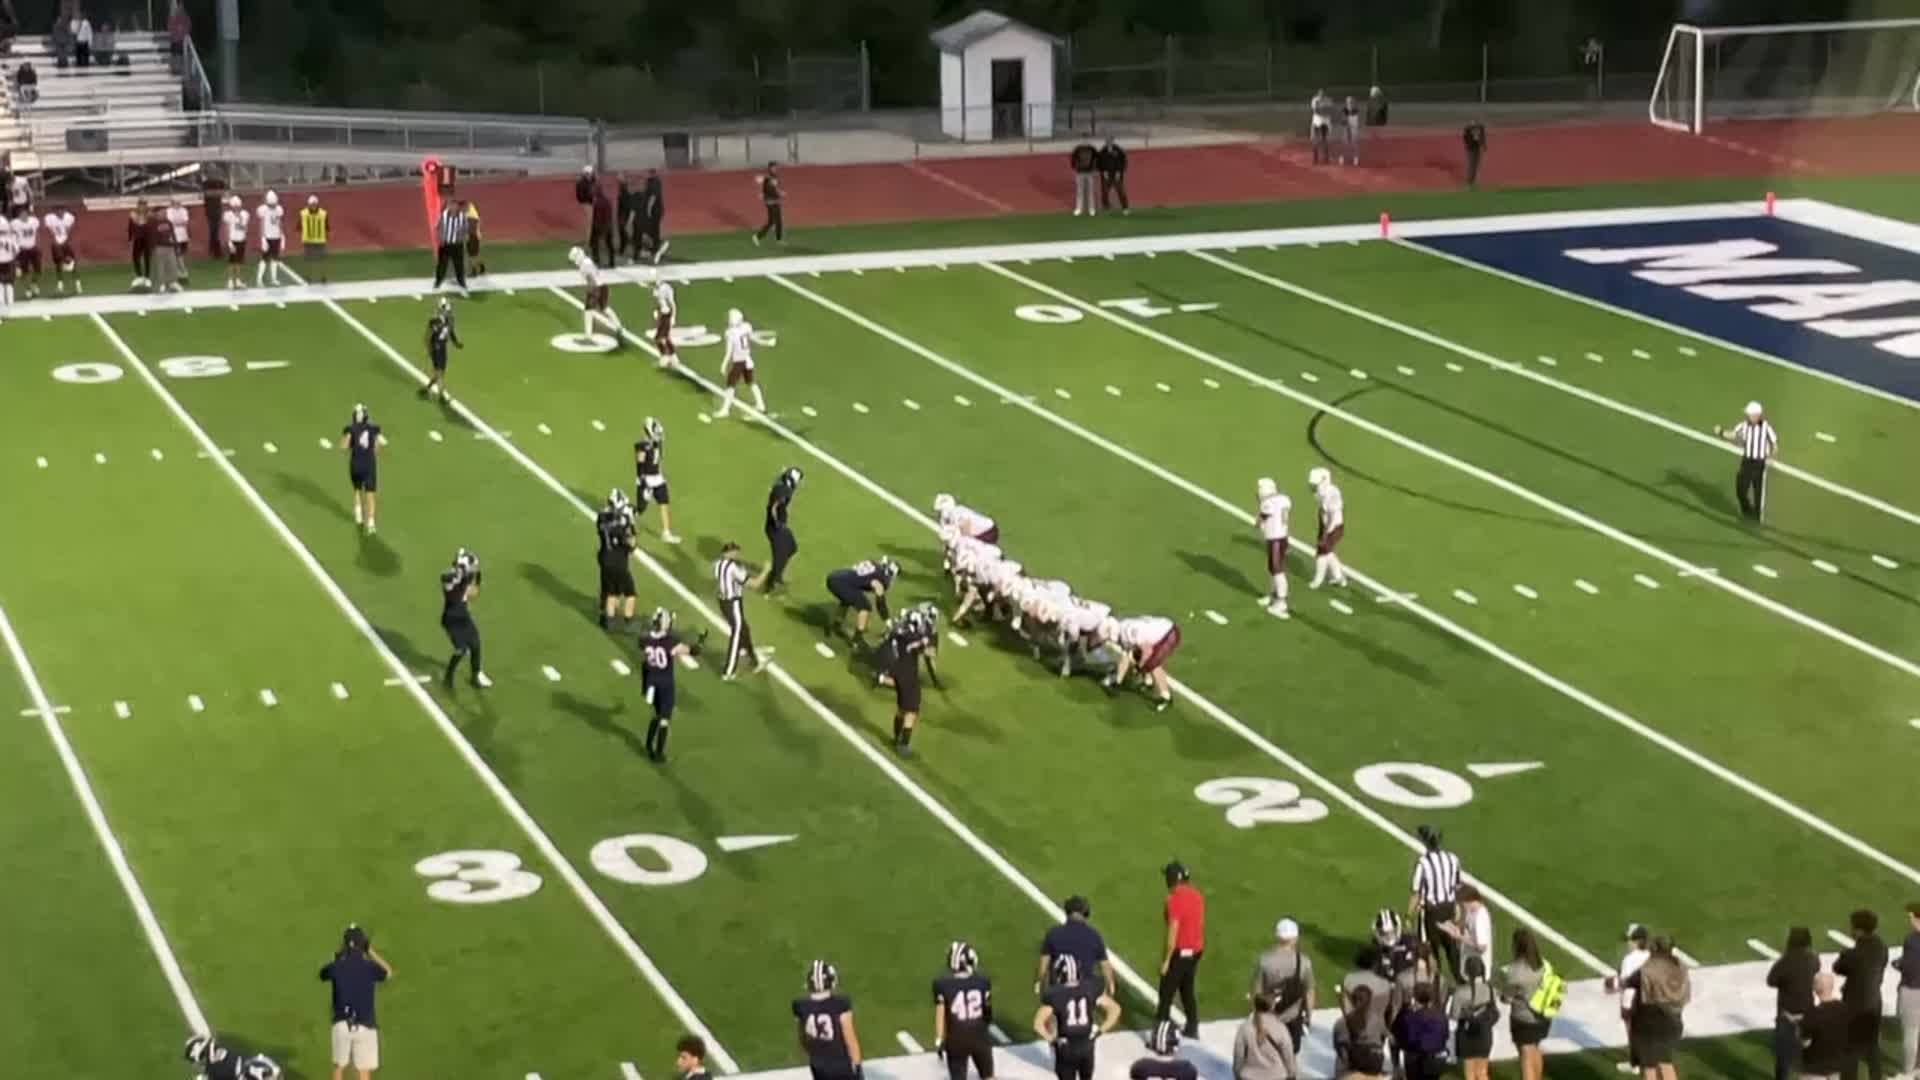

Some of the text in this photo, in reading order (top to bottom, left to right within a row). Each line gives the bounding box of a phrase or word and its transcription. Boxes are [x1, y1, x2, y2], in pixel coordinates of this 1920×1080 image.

[359, 430, 369, 449] 4
[645, 645, 668, 669] 20
[951, 990, 983, 1020] 42
[1067, 997, 1088, 1026] 11
[805, 1013, 834, 1041] 43
